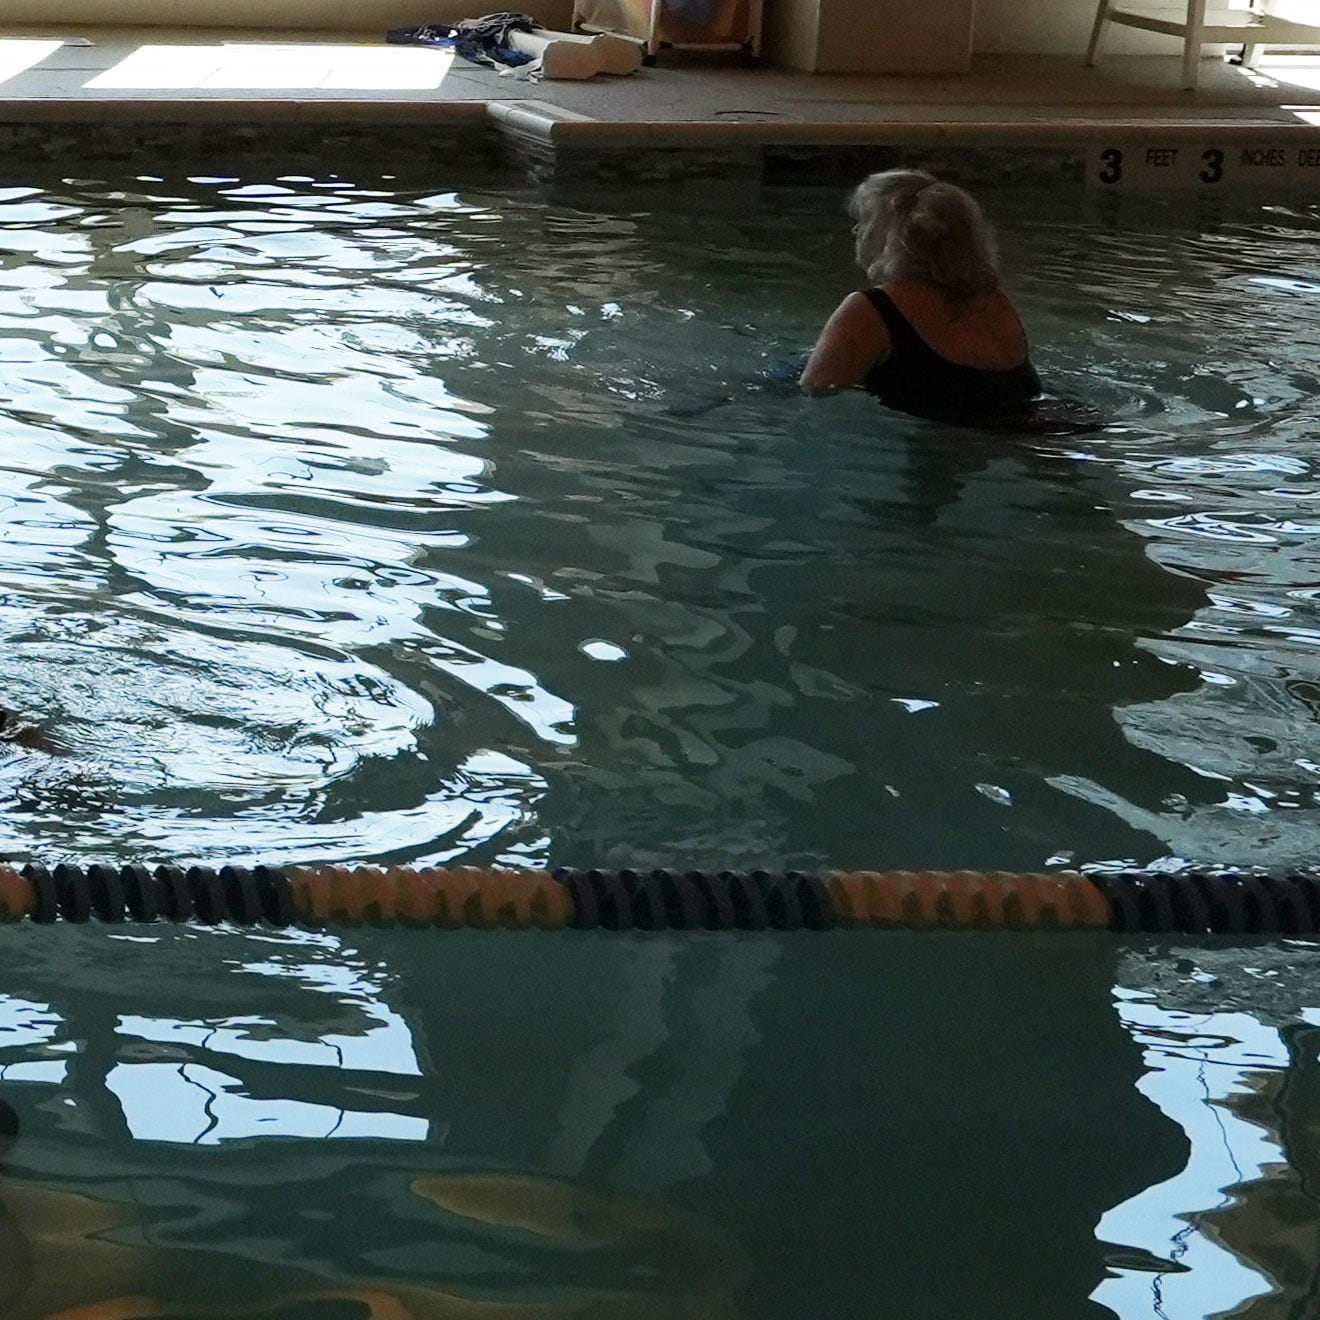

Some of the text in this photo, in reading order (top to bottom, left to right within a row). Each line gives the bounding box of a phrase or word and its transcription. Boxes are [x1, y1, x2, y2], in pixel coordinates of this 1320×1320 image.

[1099, 148, 1320, 184] 3 FEET 3 INCHES DEE
